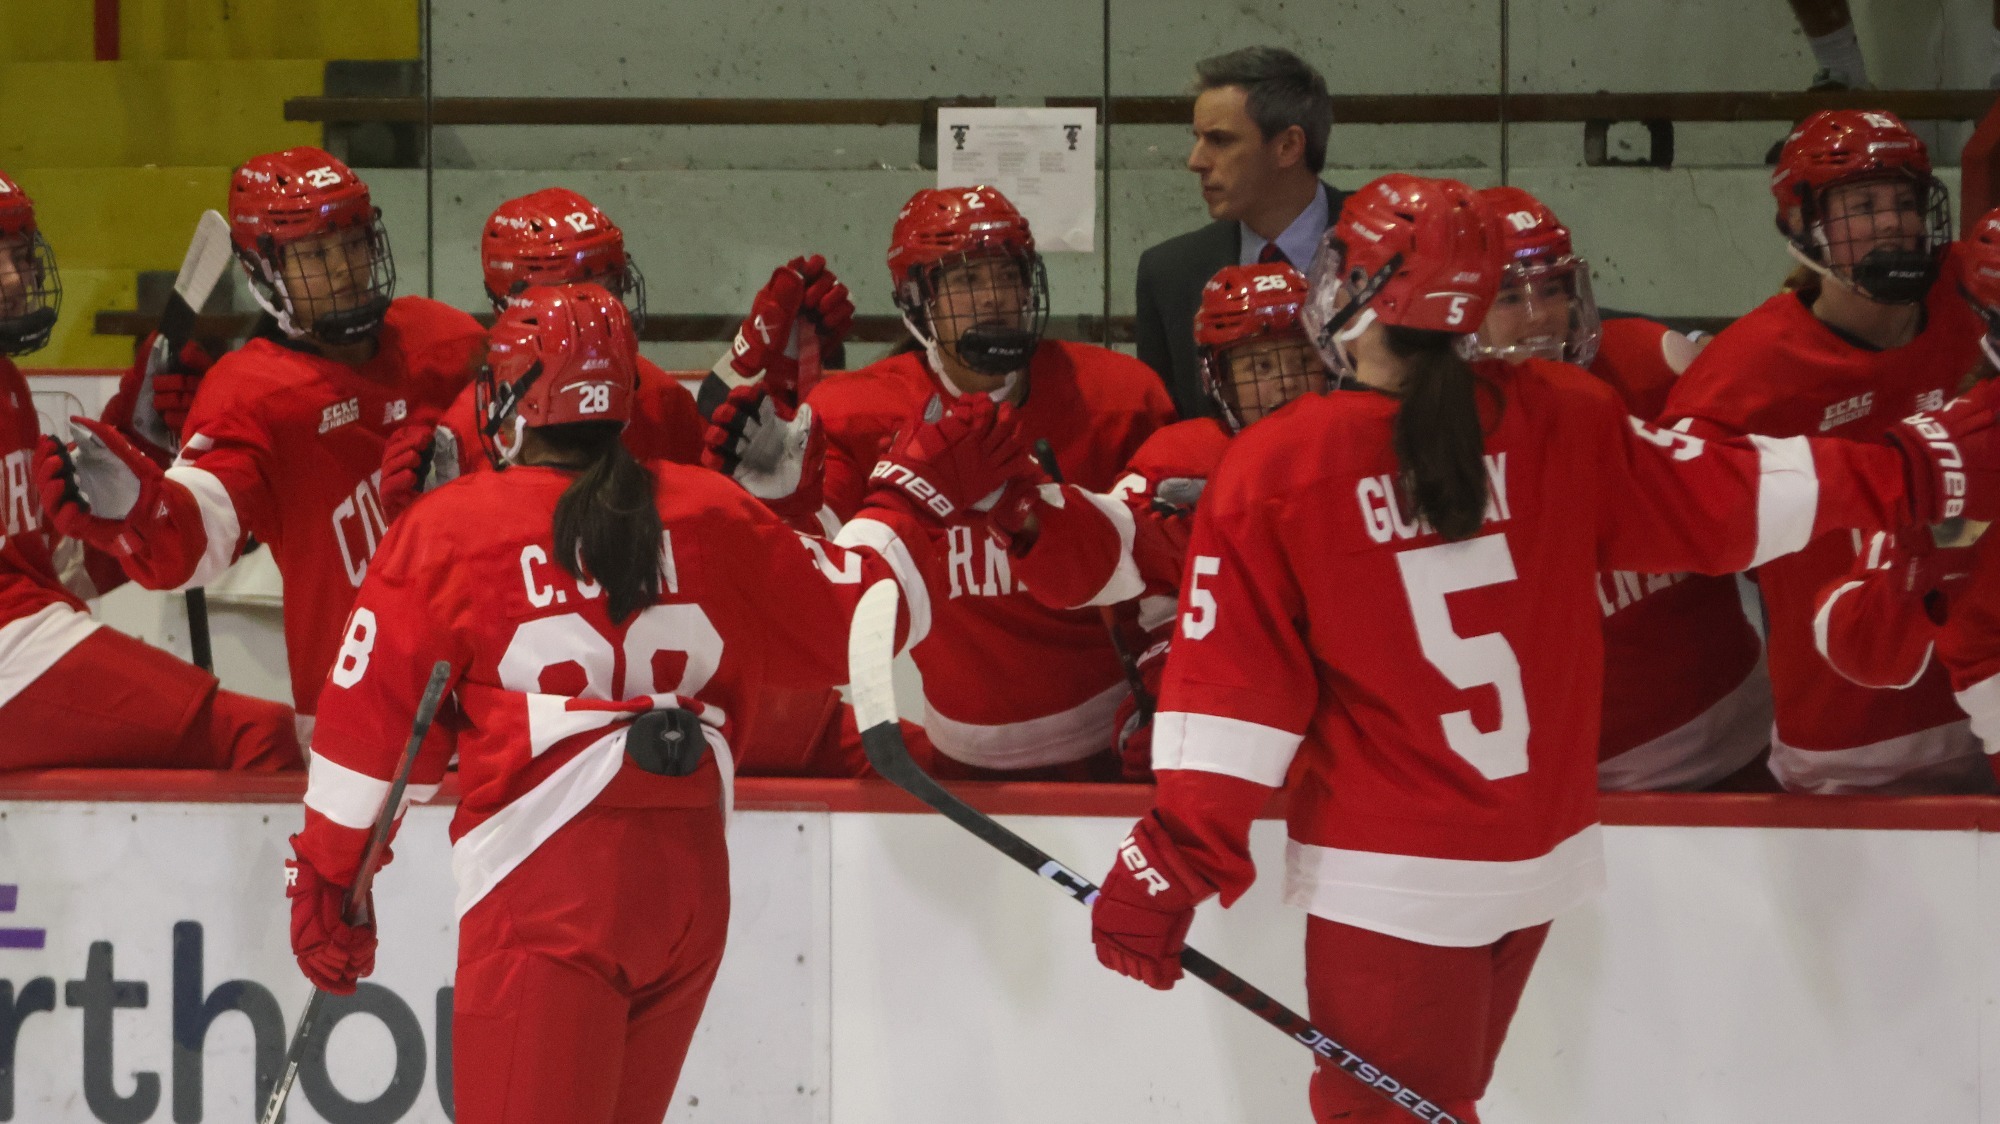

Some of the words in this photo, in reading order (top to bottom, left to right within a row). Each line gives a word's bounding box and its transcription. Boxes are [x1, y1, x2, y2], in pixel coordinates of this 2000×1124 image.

[306, 166, 341, 188] 25
[963, 192, 985, 209] 2
[564, 212, 595, 232] 12
[1506, 211, 1537, 231] 10
[1253, 274, 1287, 292] 26
[1445, 297, 1468, 324] 5
[322, 398, 358, 421] ECAC
[579, 385, 609, 413] 28
[1824, 391, 1873, 419] ECAC
[1182, 556, 1221, 640] 5
[1395, 532, 1530, 781] 5
